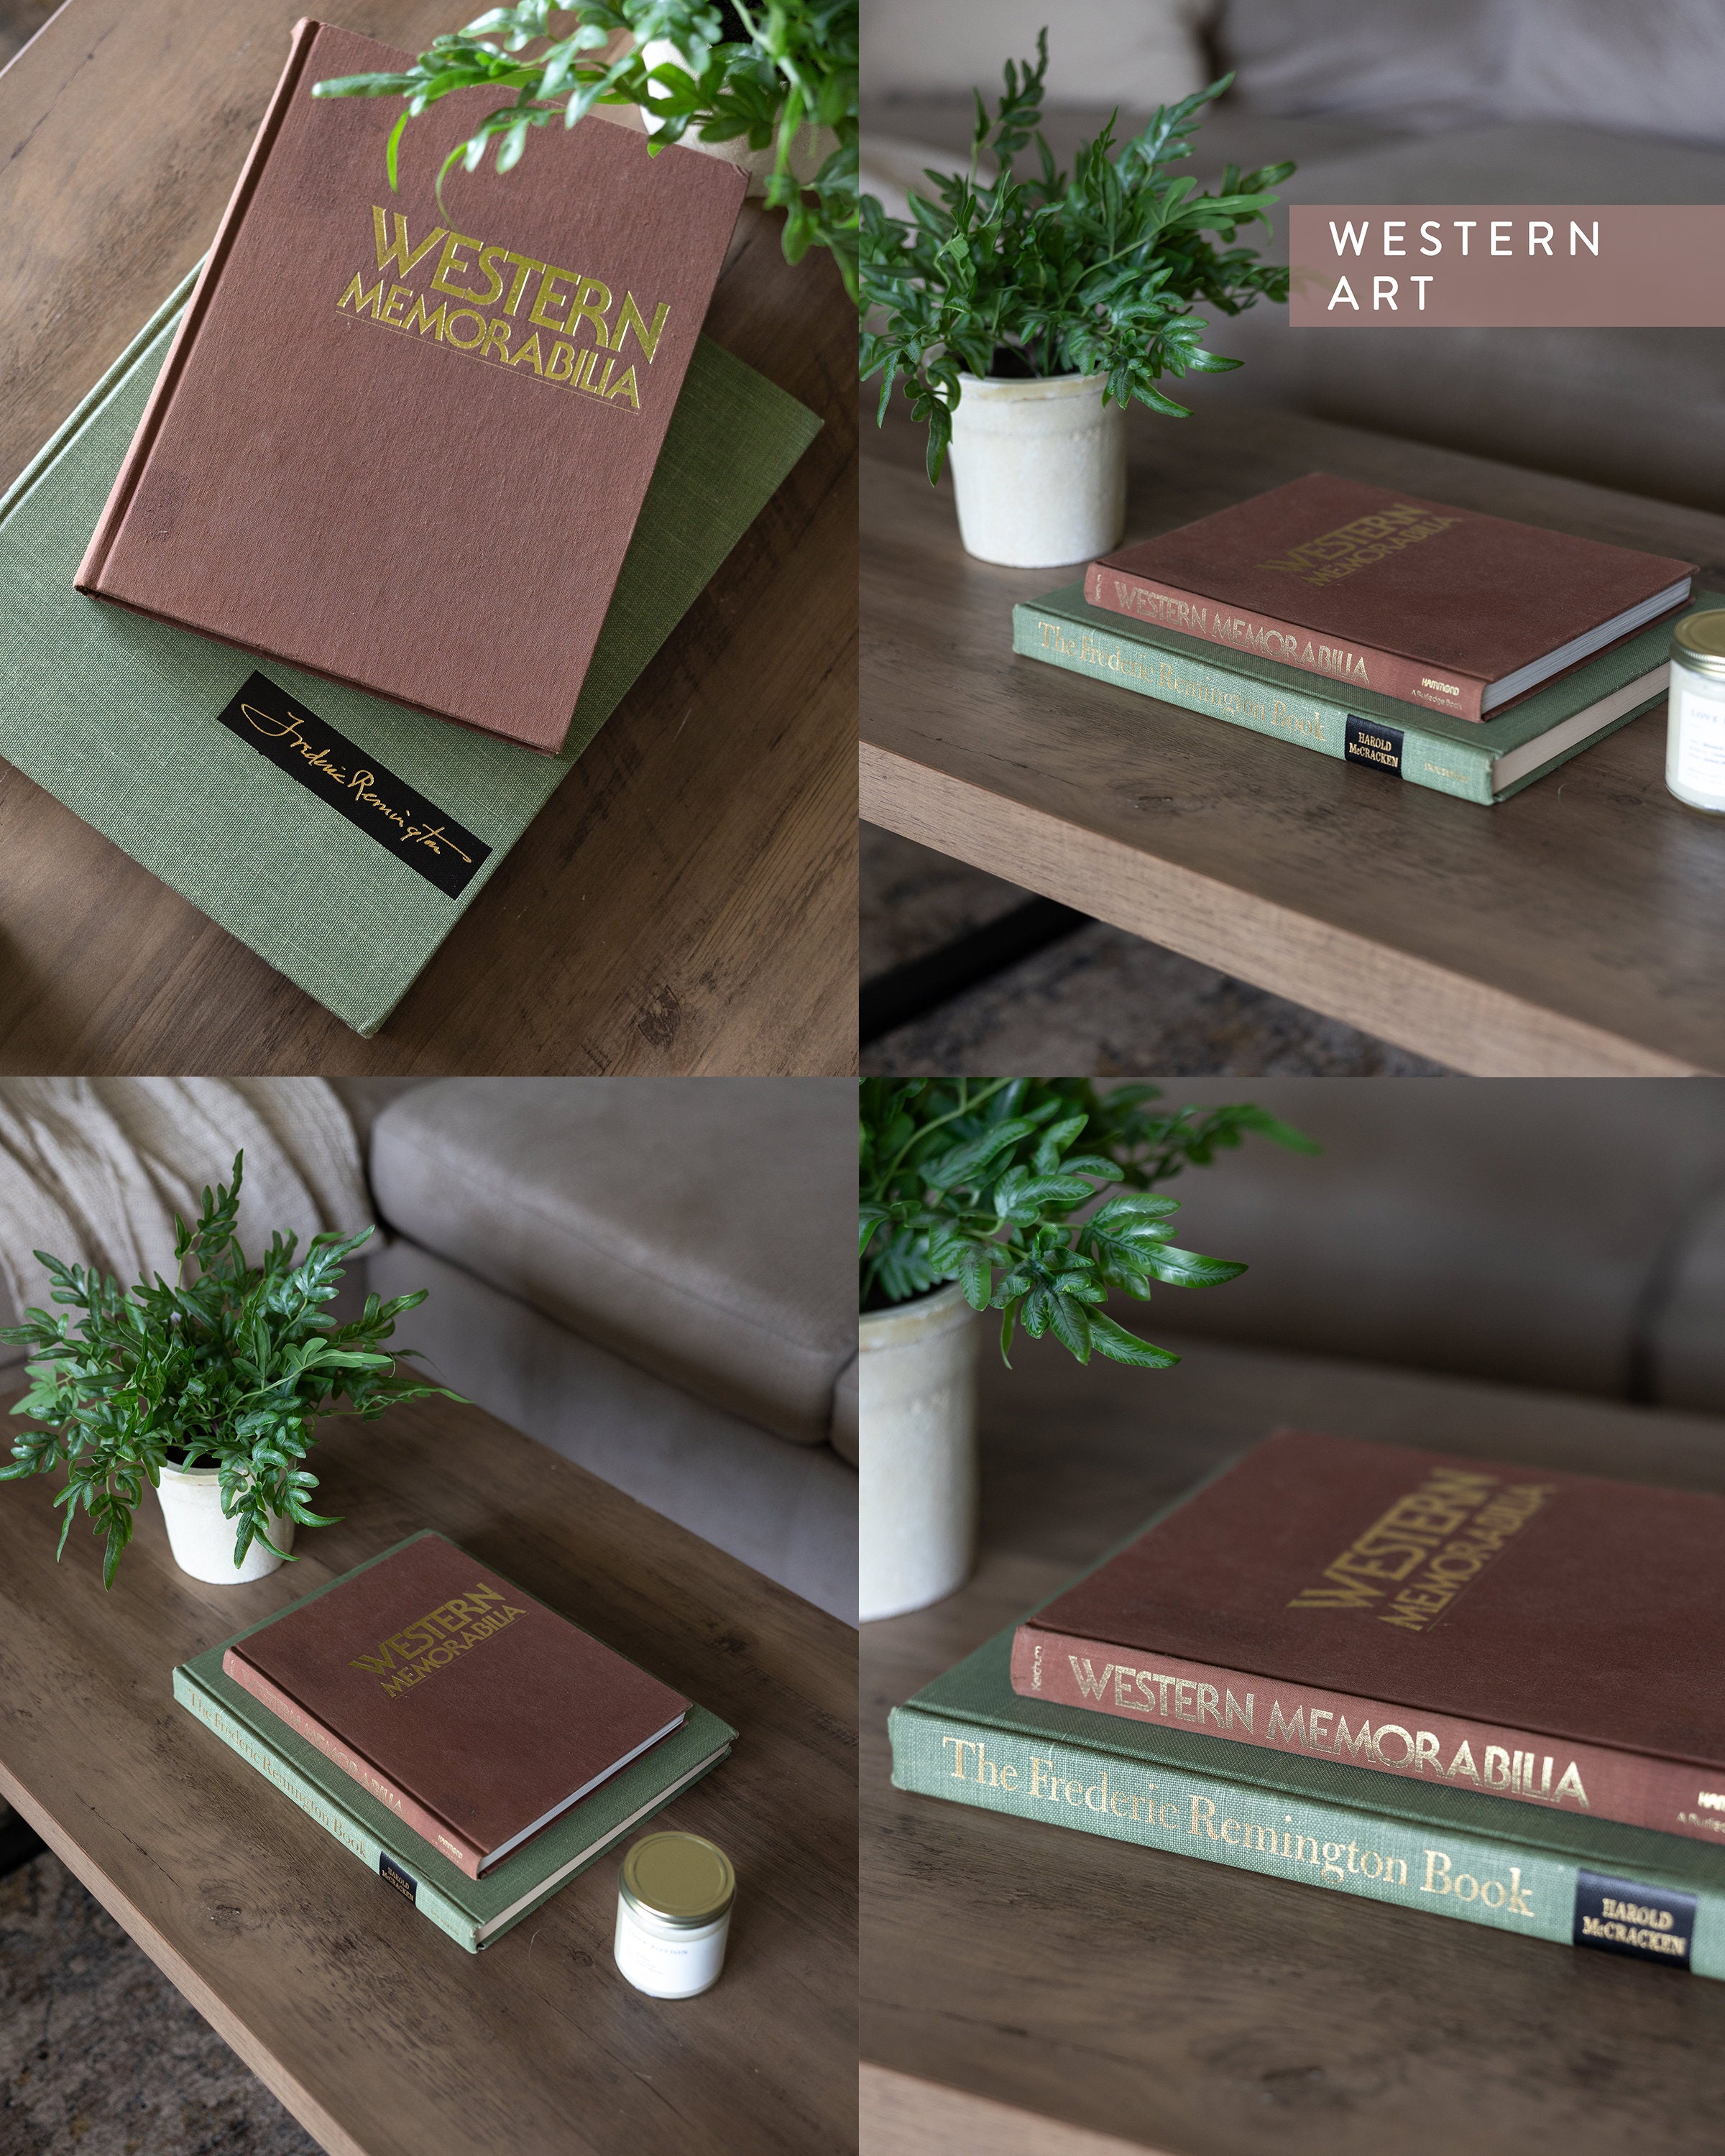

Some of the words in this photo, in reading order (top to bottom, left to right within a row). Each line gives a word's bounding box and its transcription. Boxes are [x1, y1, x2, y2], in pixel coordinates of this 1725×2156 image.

[372, 205, 671, 364] WESTERN
[336, 272, 640, 409] MEMORABILIA
[1254, 503, 1432, 572] WESTERN
[1039, 622, 1076, 657] The
[1079, 635, 1154, 683] Frederic
[1159, 661, 1266, 719] Remington
[1271, 699, 1326, 741] Book
[1115, 581, 1207, 634] WESTERN
[1212, 613, 1369, 684] MEMORABILIA
[241, 704, 345, 784] Frederic
[347, 770, 472, 863] Remington
[1349, 742, 1399, 768] McCRACKEN
[1358, 732, 1392, 751] HAROLD
[1286, 1467, 1501, 1608] WESTERN
[348, 1583, 506, 1675] WESTERN
[380, 1605, 527, 1698] MEMORABILIA
[242, 1669, 300, 1730] WESTERN
[1068, 1654, 1254, 1736] WESTERN
[1266, 1699, 1590, 1810] MEMORABILIA
[188, 1688, 211, 1721] The
[214, 1713, 259, 1764] Frederic
[262, 1755, 330, 1827] Remington
[334, 1816, 367, 1859] Book
[942, 1736, 1018, 1791] The
[1028, 1756, 1178, 1831] Frederic
[1187, 1793, 1409, 1886] Remington
[1420, 1848, 1535, 1917] Book
[388, 1867, 410, 1890] HAROLD
[1601, 1897, 1673, 1930] HAROLD
[1582, 1915, 1686, 1957] McCRACKEN
